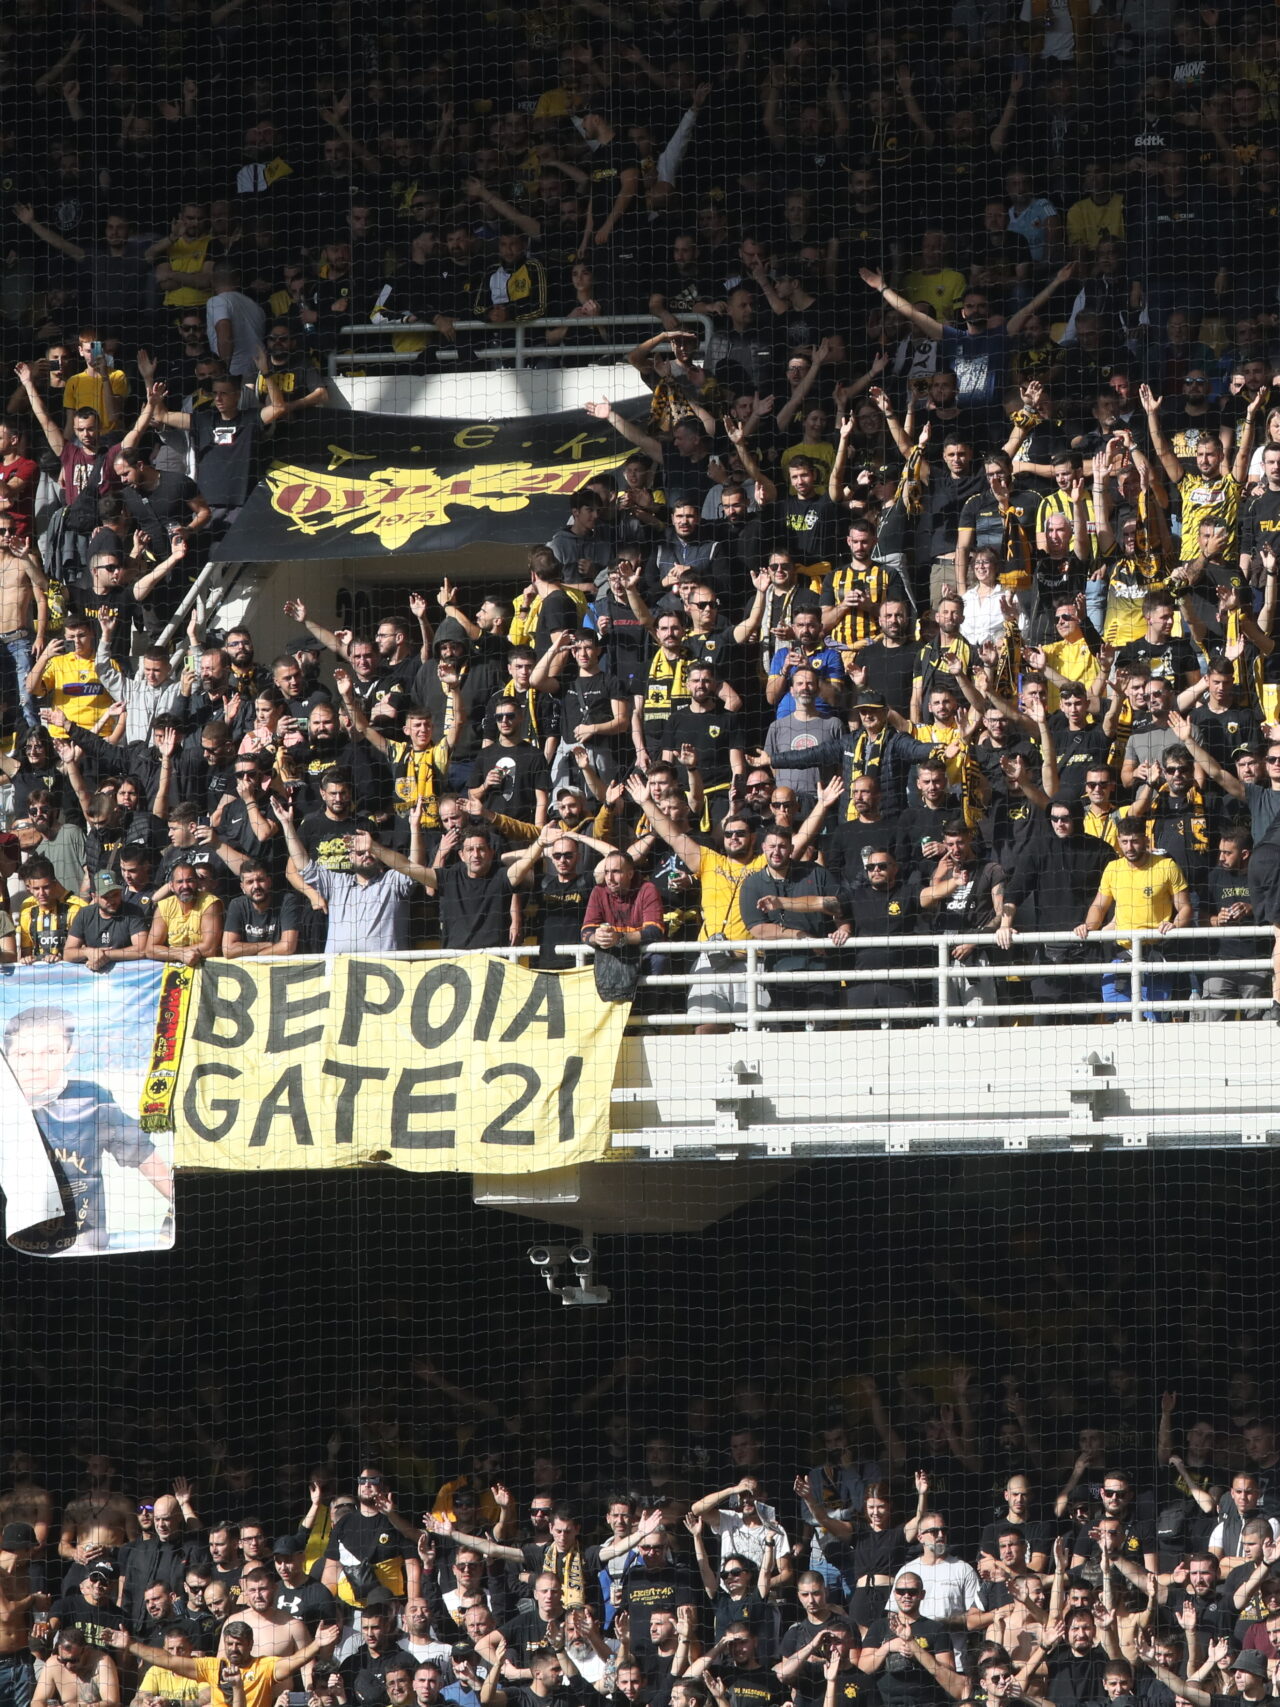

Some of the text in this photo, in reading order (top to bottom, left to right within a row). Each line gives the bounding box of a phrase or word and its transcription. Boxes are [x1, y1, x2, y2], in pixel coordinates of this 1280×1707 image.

[83, 685, 101, 694] TIM
[191, 959, 567, 1053] ΒΕΡΟΙΑ
[183, 1057, 584, 1148] GATE 21
